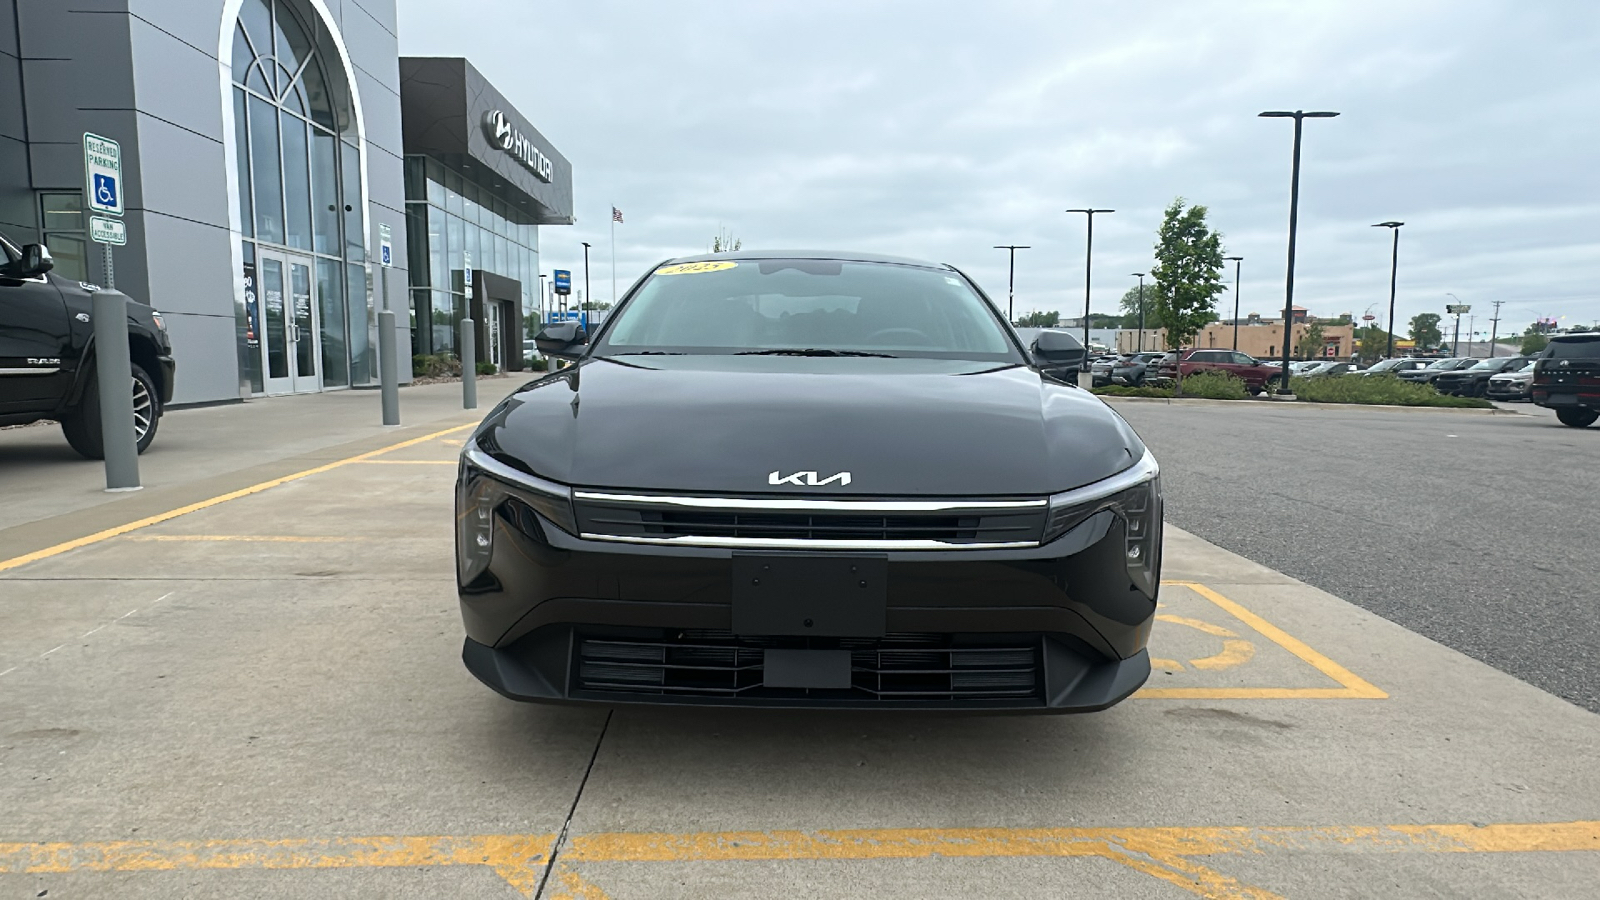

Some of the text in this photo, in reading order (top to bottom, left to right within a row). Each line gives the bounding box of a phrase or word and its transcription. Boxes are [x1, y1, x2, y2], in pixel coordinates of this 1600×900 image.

[87, 141, 117, 159] RESERVED
[514, 129, 553, 183] HYUNDAI
[88, 154, 118, 171] PARKING
[94, 229, 124, 241] ACCESSIBLE
[103, 222, 113, 231] VAN
[768, 470, 852, 487] KIA
